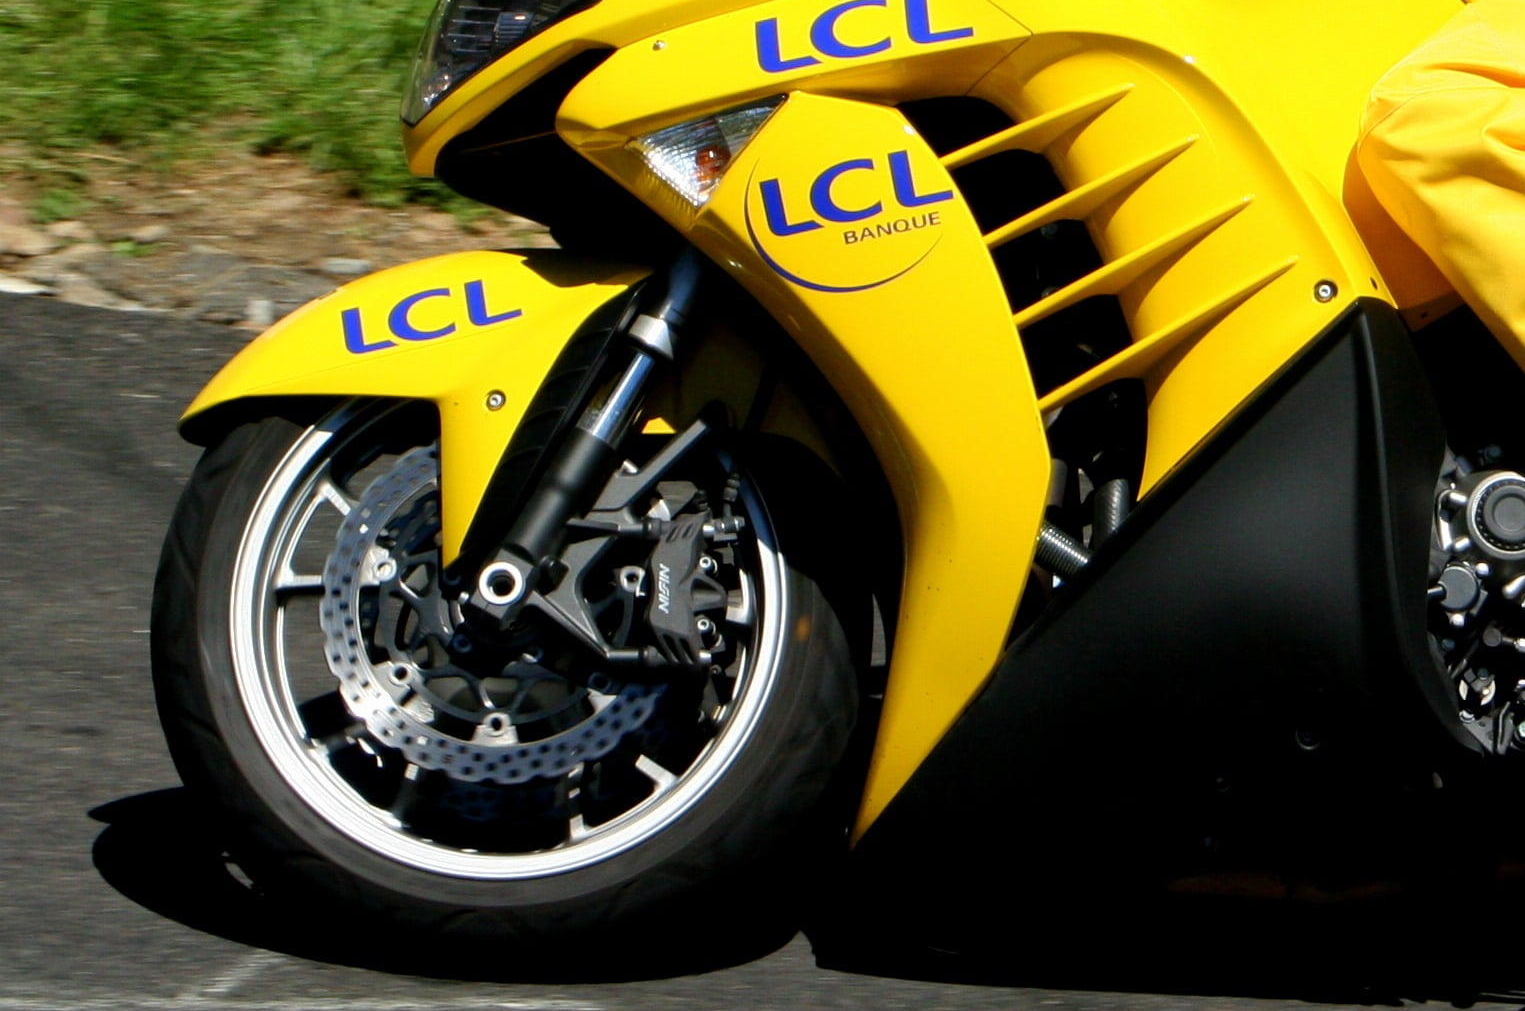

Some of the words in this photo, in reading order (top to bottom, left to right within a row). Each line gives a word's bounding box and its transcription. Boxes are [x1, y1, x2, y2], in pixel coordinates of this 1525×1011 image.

[759, 149, 954, 237] LCL
[843, 211, 942, 245] BANQUE
[341, 279, 522, 354] LCL
